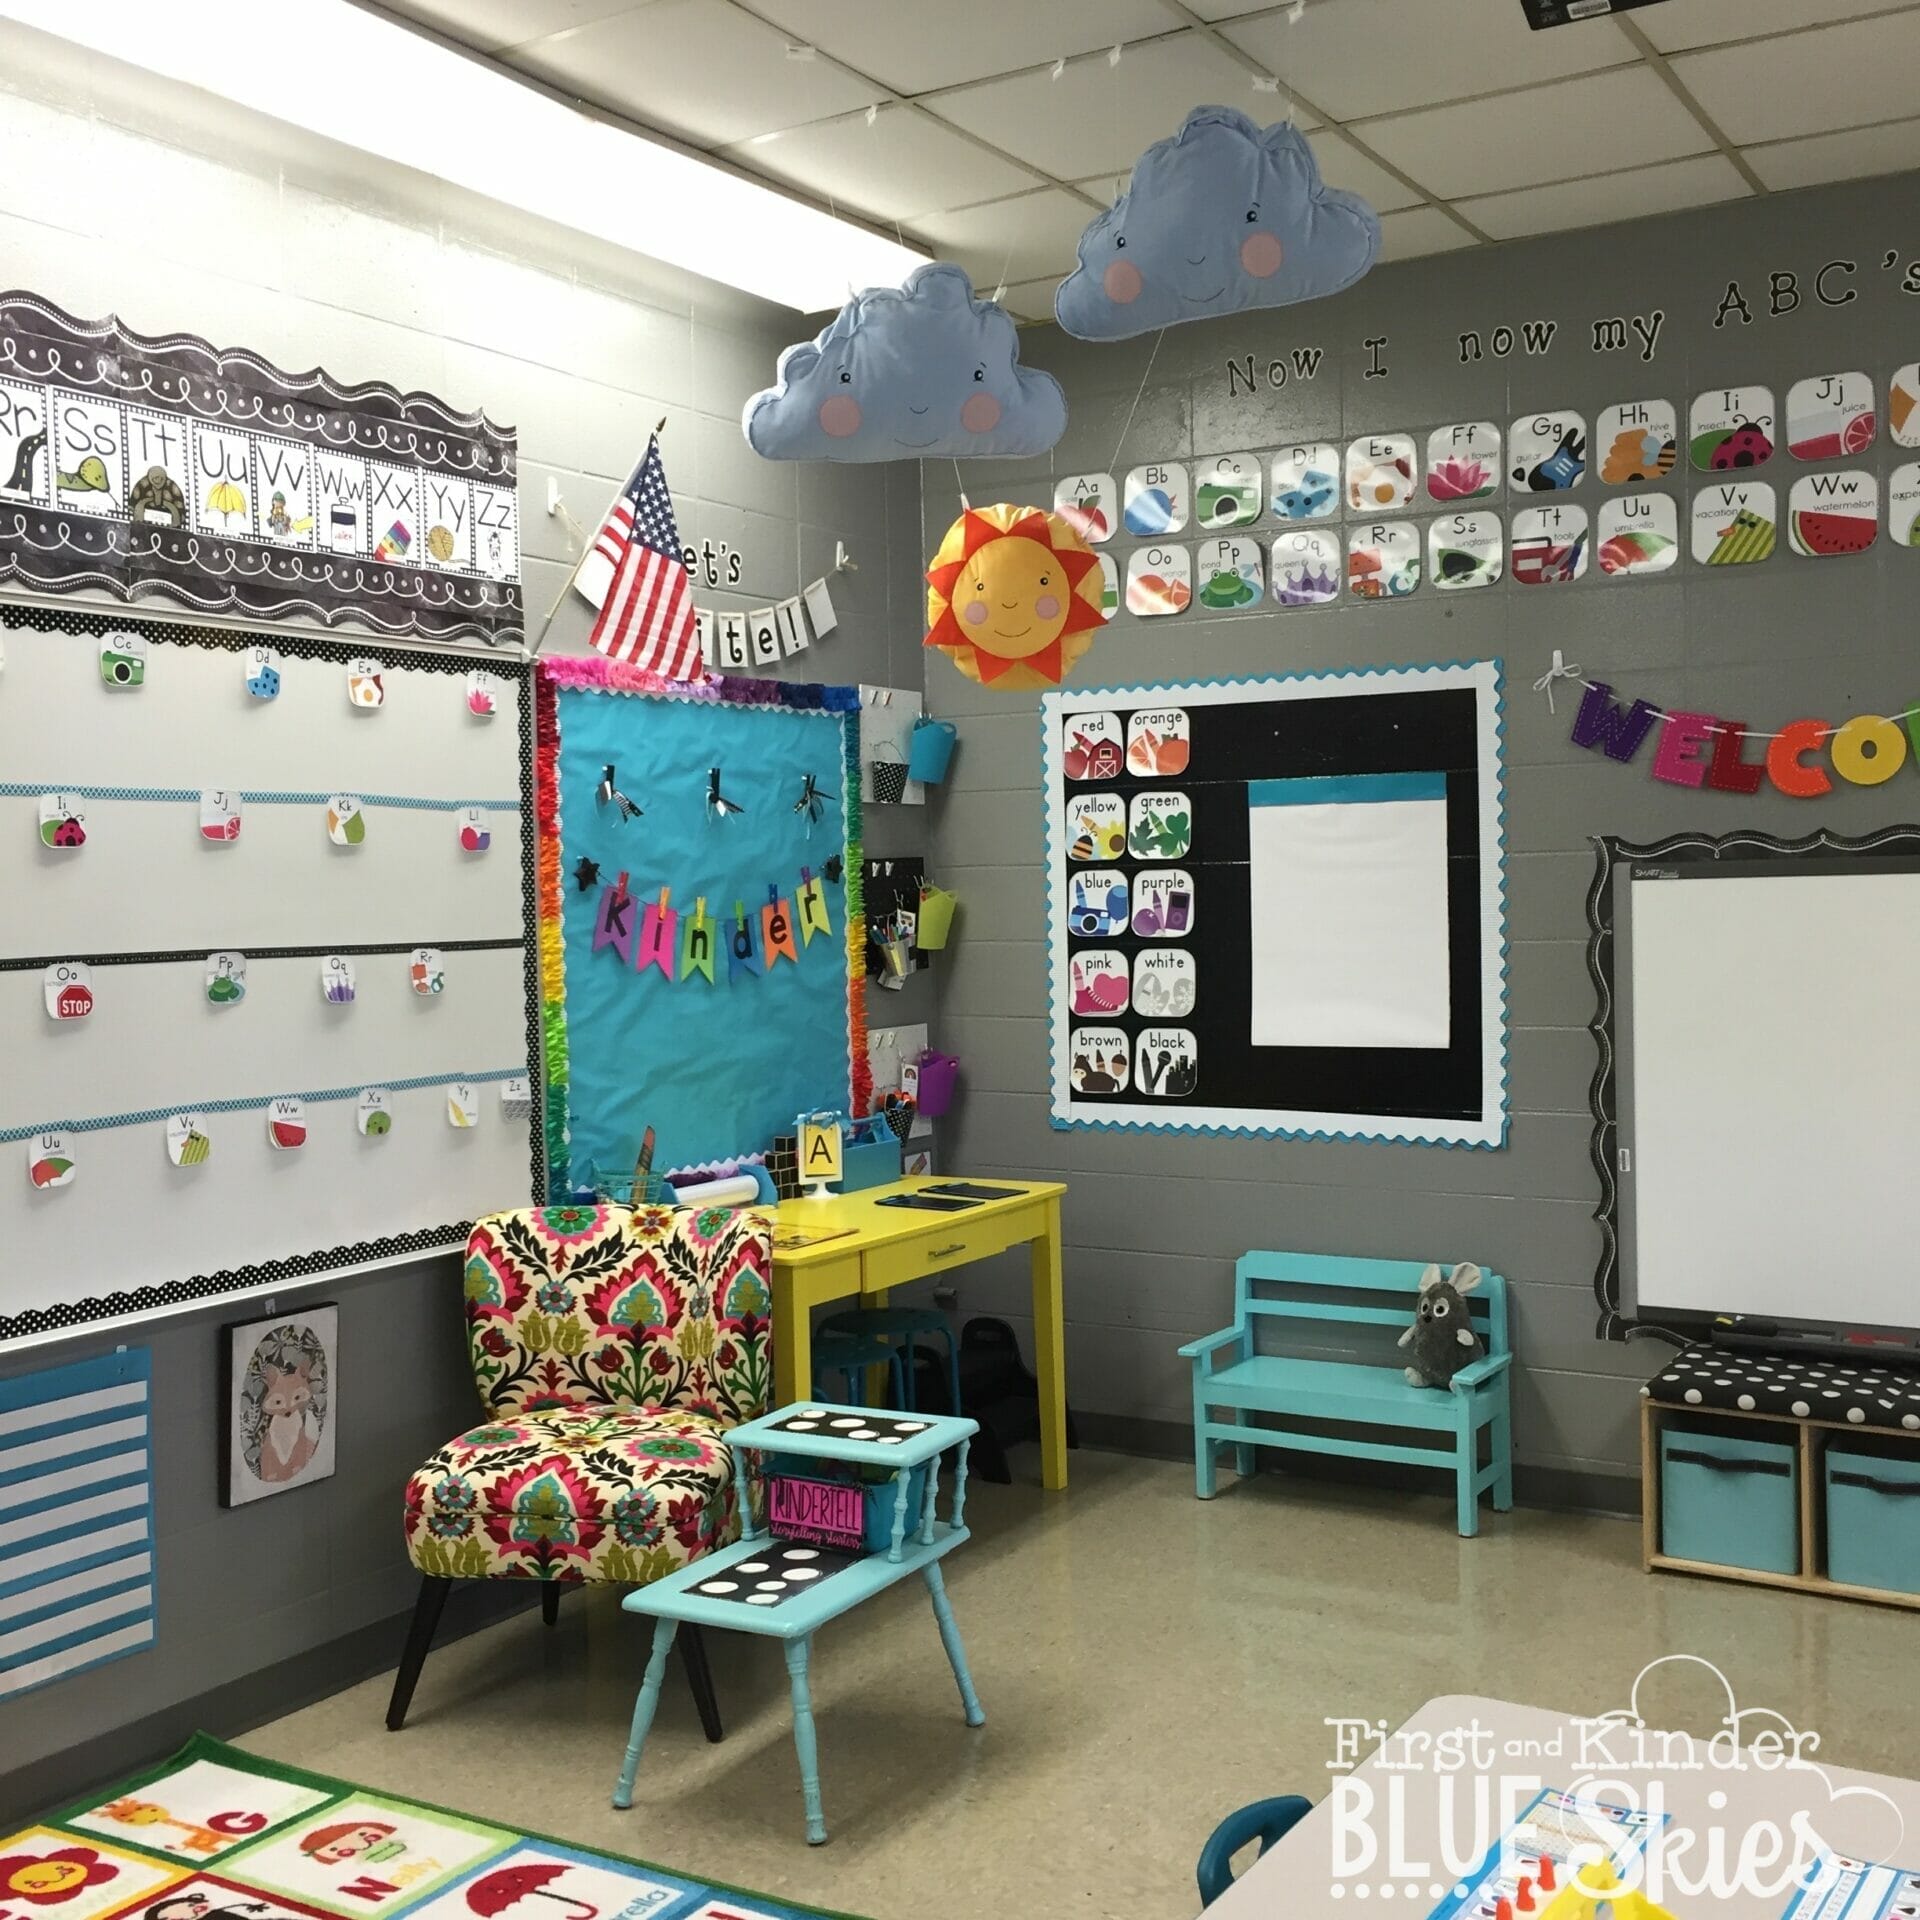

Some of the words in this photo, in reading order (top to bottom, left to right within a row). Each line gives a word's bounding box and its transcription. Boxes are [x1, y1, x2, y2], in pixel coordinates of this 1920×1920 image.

[1227, 349, 1322, 397] Now
[1364, 337, 1388, 379] I
[1460, 321, 1556, 362] now
[1592, 310, 1664, 361] my
[1816, 377, 1844, 406] Jj
[1724, 391, 1739, 412] Ii
[1842, 402, 1867, 415] juice
[1619, 404, 1649, 426] Hh
[64, 407, 116, 456] Ss
[1532, 417, 1563, 442] Gg
[1650, 422, 1670, 431] hive
[1697, 421, 1727, 430] insect
[132, 418, 177, 466] Tt
[1452, 426, 1477, 446] Ff
[1292, 446, 1317, 466] Dd
[1369, 439, 1393, 457] Ee
[1471, 451, 1498, 459] flower
[199, 434, 248, 484] Uu
[258, 445, 304, 491] Vv
[1216, 458, 1241, 475] Cc
[319, 463, 365, 501] Ww
[1146, 467, 1168, 485] Bb
[373, 468, 413, 513] Xx
[1074, 478, 1098, 495] Aa
[1811, 475, 1859, 496] Ww
[1721, 486, 1748, 506] Vv
[430, 481, 466, 533] Yy
[476, 490, 511, 530] Zz
[1623, 498, 1650, 518] Uu
[1695, 508, 1738, 519] vacation
[1813, 500, 1875, 512] watermelon
[1453, 516, 1477, 534] Ss
[1537, 508, 1562, 527] Tt
[1372, 526, 1397, 544] Rr
[1554, 532, 1575, 541] tools
[1218, 541, 1240, 565] Pp
[1292, 535, 1325, 558] Qq
[683, 540, 741, 586] et's
[1147, 549, 1172, 565] Oo
[1201, 561, 1221, 570] pond
[1275, 560, 1299, 570] queen
[113, 635, 132, 650] Cc
[696, 606, 801, 664] ite!
[256, 650, 270, 664] Dd
[358, 662, 372, 674] Ee
[477, 674, 488, 685] Ff
[1082, 715, 1104, 732] red
[1135, 712, 1183, 730] orange
[1571, 680, 1920, 798] WELCO
[58, 796, 67, 810] Ii
[213, 792, 228, 811] Jj
[338, 800, 352, 812] Kk
[1075, 797, 1117, 820] yellow
[1141, 797, 1180, 814] green
[1085, 873, 1111, 889] blue
[1142, 873, 1185, 896] purple
[218, 957, 233, 974] Pp
[331, 957, 348, 975] Qq
[1086, 953, 1112, 975] pink
[1145, 953, 1184, 968] white
[56, 967, 77, 981] Oo
[62, 1000, 91, 1014] STOP
[1080, 1031, 1122, 1047] brown
[1150, 1032, 1185, 1049] black
[276, 1102, 298, 1114] Ww
[180, 1116, 195, 1129] Vv
[42, 1136, 60, 1149] Uu
[809, 1134, 832, 1164] A
